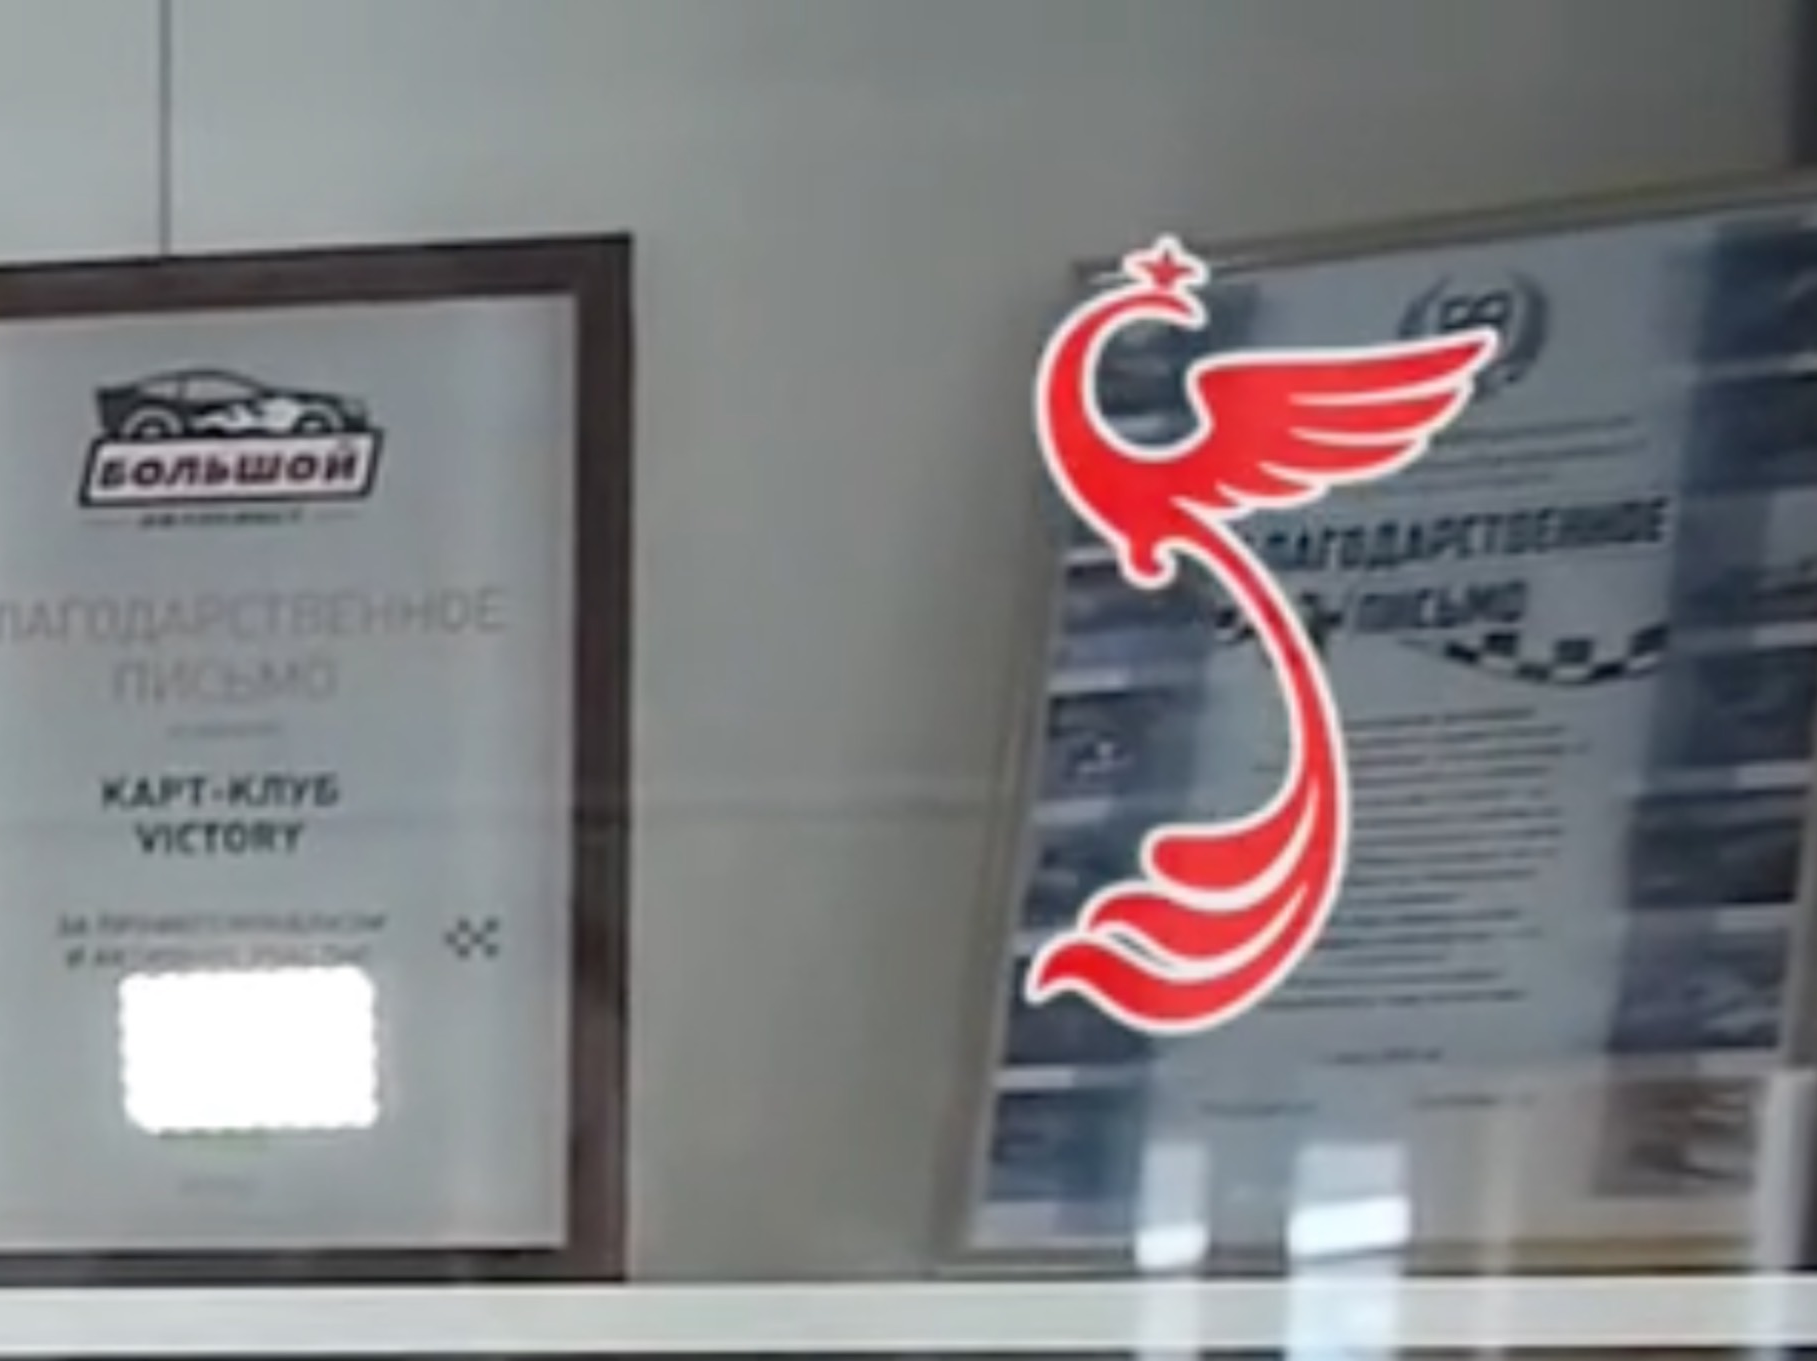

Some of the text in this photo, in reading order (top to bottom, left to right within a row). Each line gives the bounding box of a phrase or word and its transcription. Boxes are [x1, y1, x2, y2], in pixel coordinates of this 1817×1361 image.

[100, 438, 359, 489] БОЛЬШОЙ
[111, 655, 340, 704] ПИСЬМО
[101, 770, 340, 811] КАРТ-КЛУБ
[133, 820, 305, 855] VICTORY
